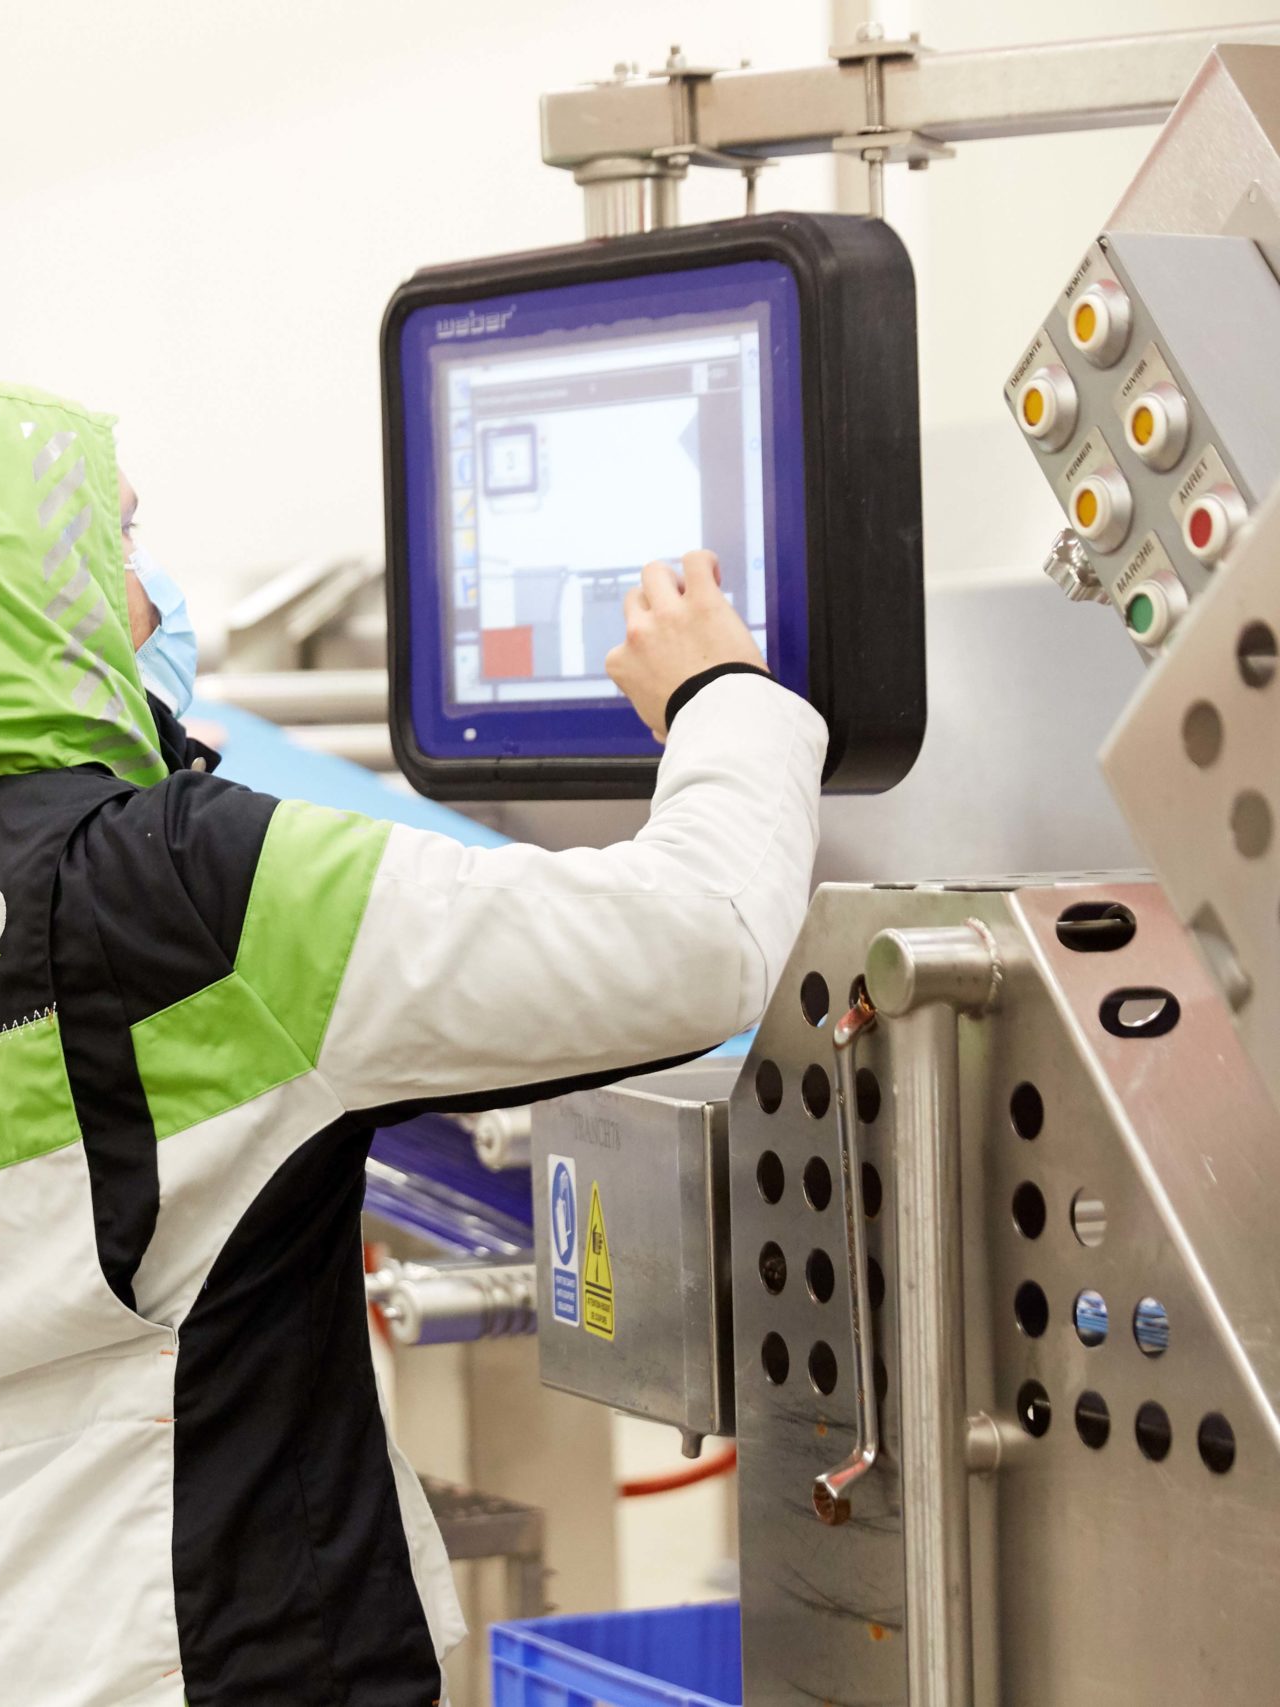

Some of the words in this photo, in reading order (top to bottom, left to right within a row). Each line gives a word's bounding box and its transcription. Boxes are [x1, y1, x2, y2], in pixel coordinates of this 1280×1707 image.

[1065, 257, 1091, 298] MONTEE
[436, 309, 513, 339] weber
[1010, 339, 1042, 388] DESCENTE
[1065, 441, 1092, 482] FERMER
[1178, 457, 1208, 505] ARRET
[1116, 540, 1154, 594] MARCHE
